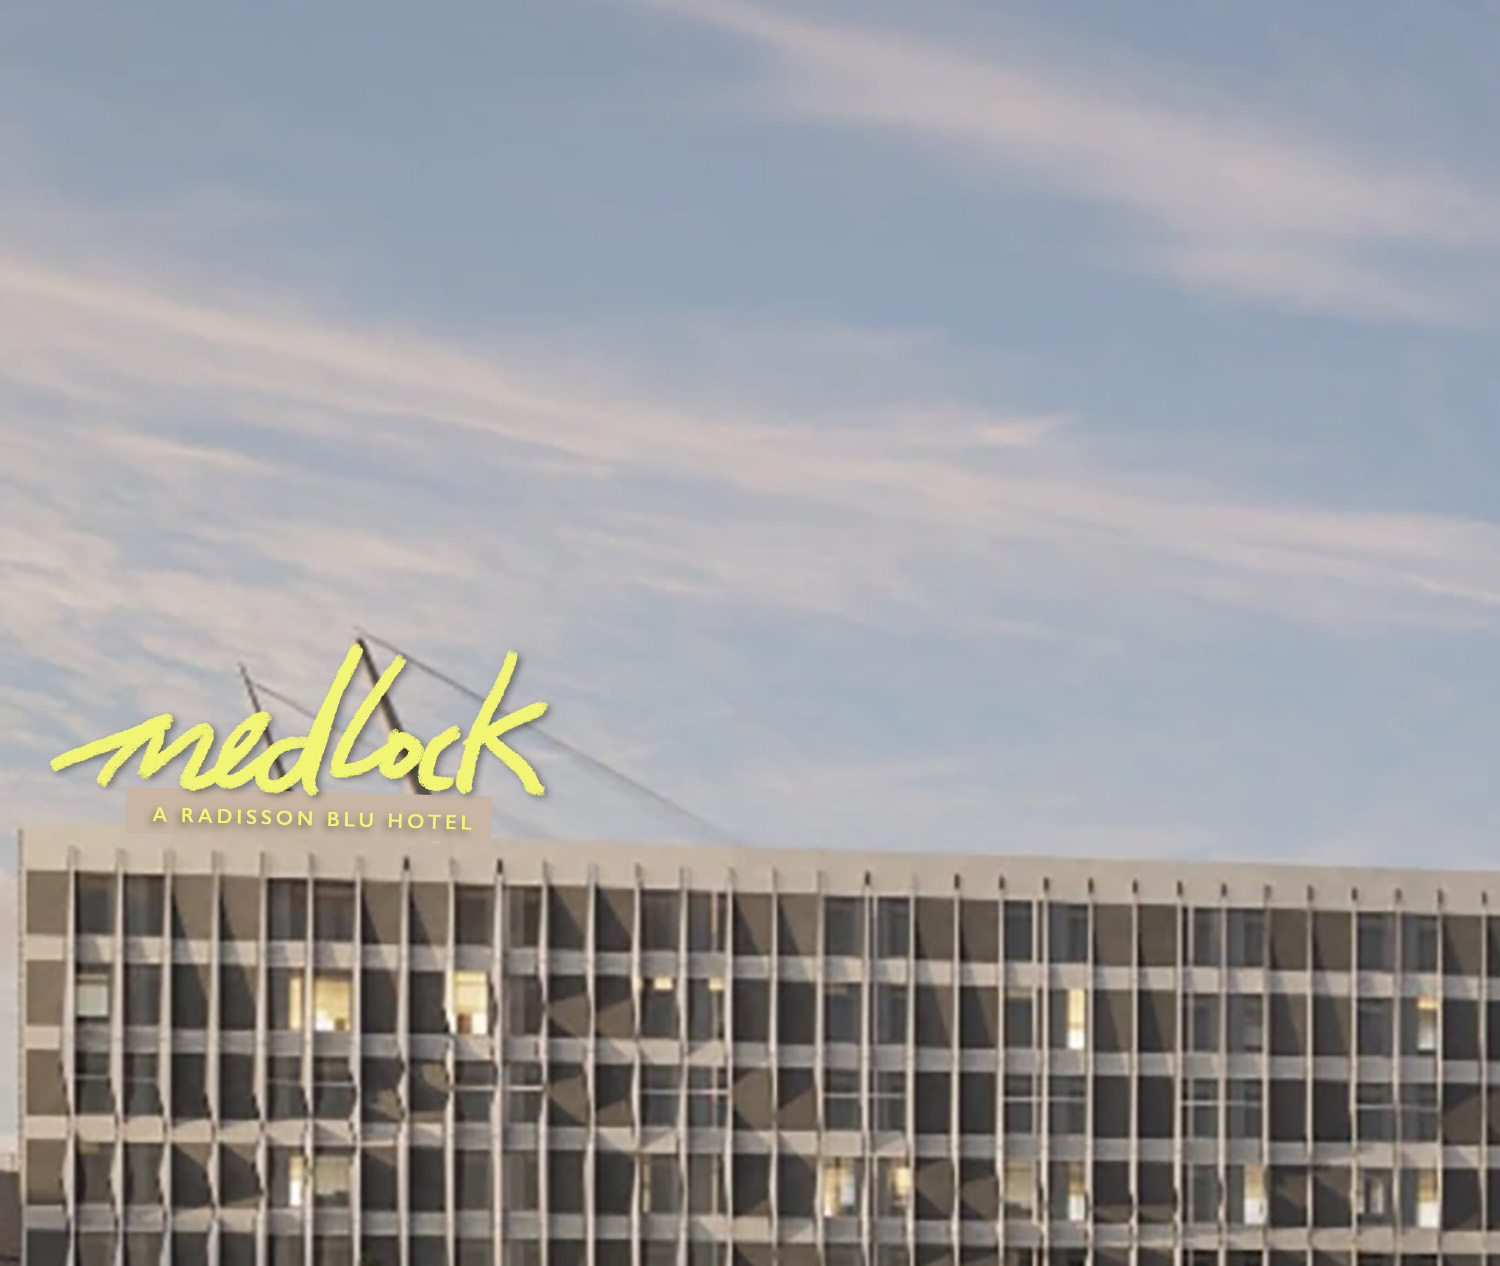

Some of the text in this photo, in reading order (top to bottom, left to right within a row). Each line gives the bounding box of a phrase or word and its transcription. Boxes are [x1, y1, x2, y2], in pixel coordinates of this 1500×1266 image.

[50, 643, 548, 796] medlock
[153, 807, 472, 831] A RADISSON BLU HOTEL
